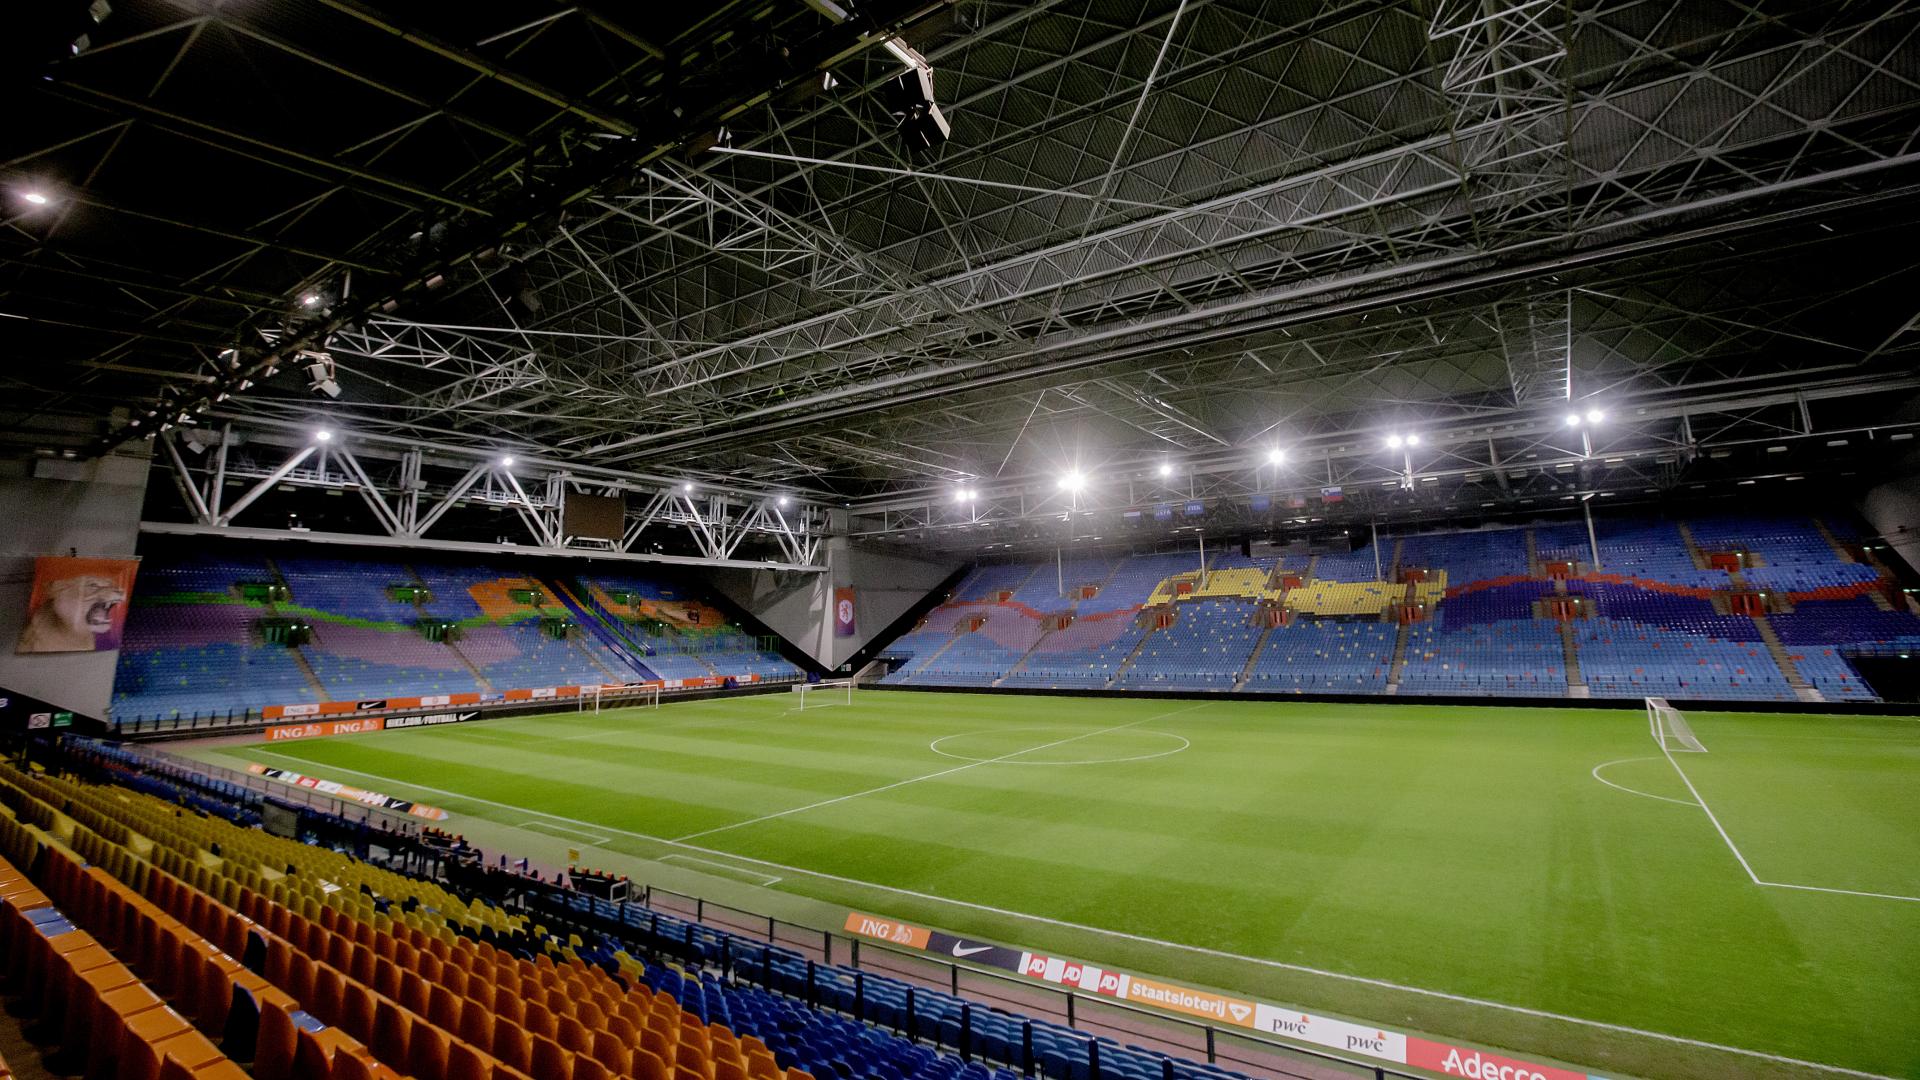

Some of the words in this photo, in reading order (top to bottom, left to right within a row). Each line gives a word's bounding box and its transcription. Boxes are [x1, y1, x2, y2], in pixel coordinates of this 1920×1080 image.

[273, 728, 302, 739] ING
[334, 722, 361, 734] ING
[860, 919, 889, 939] ING
[1028, 958, 1046, 973] AD
[1063, 966, 1081, 982] AD
[1100, 974, 1119, 991] AD
[1272, 1019, 1306, 1034] pwc
[1346, 1035, 1384, 1052] pwc
